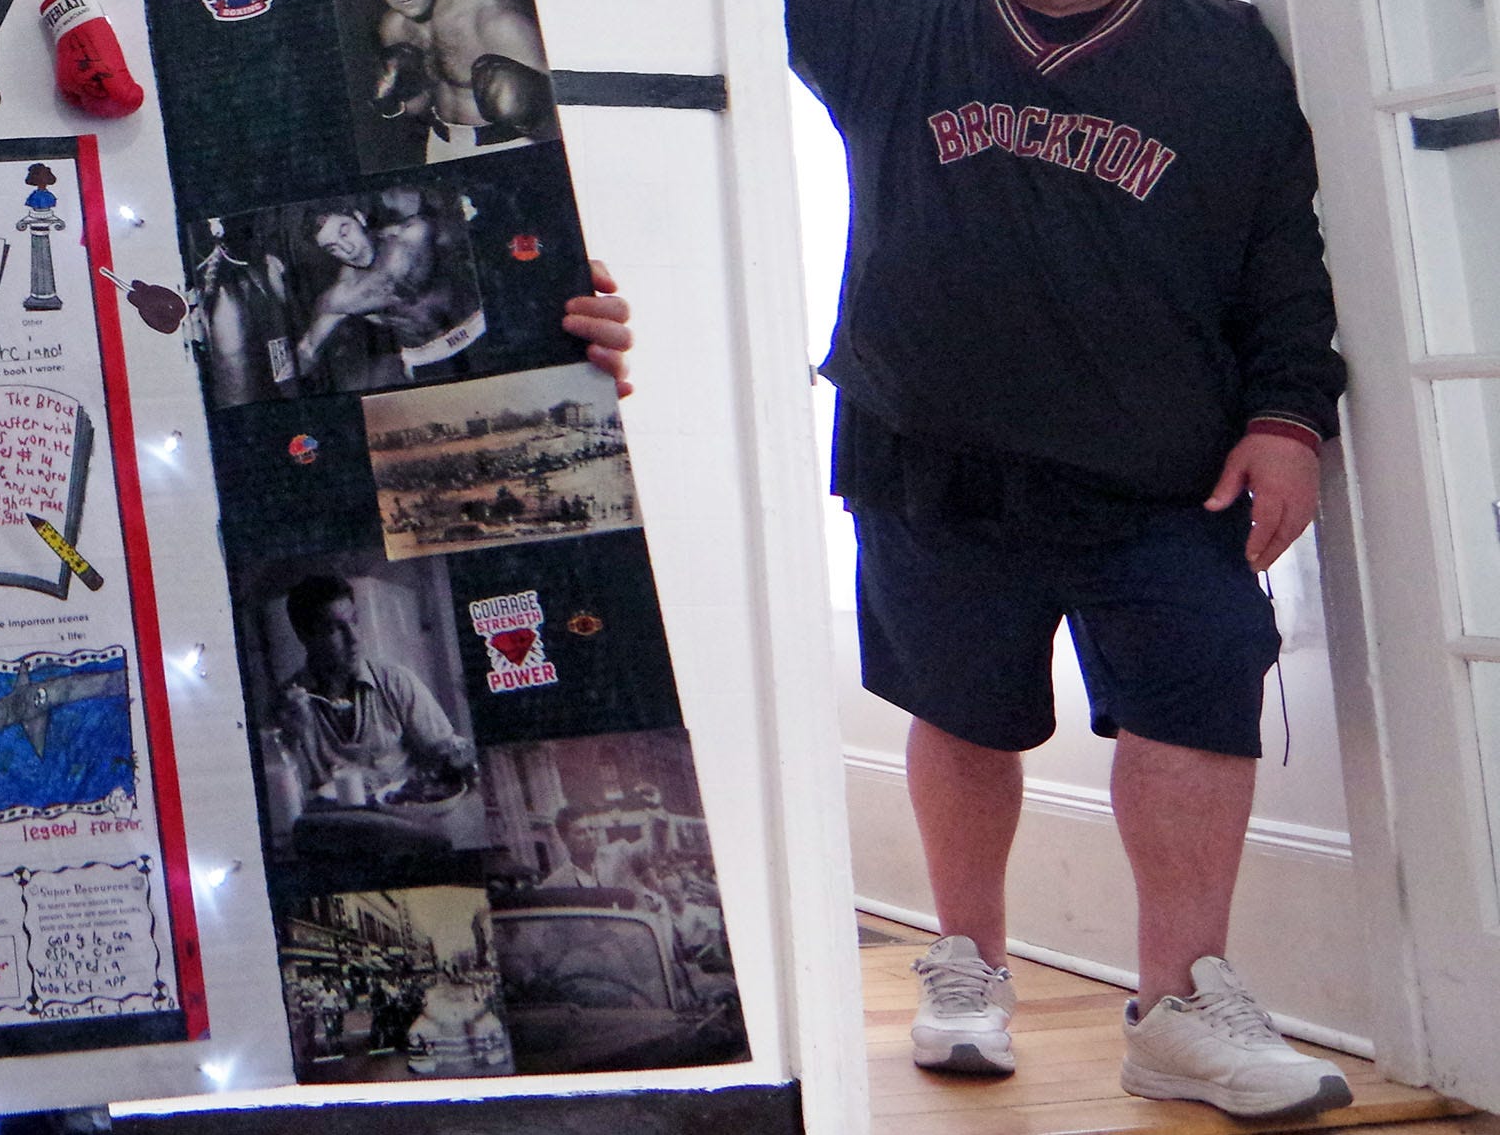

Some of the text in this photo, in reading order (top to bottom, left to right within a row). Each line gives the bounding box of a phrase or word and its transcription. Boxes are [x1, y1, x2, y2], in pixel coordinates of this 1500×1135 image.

[223, 3, 262, 15] BOXING
[928, 100, 1176, 202] BROCKTON
[3, 367, 26, 376] book
[6, 392, 30, 406] The
[471, 593, 537, 620] COURAGE
[8, 617, 55, 628] important
[58, 614, 89, 624] scenes
[476, 612, 541, 632] STRENGTH
[490, 665, 555, 690] POWER
[22, 821, 77, 842] legend
